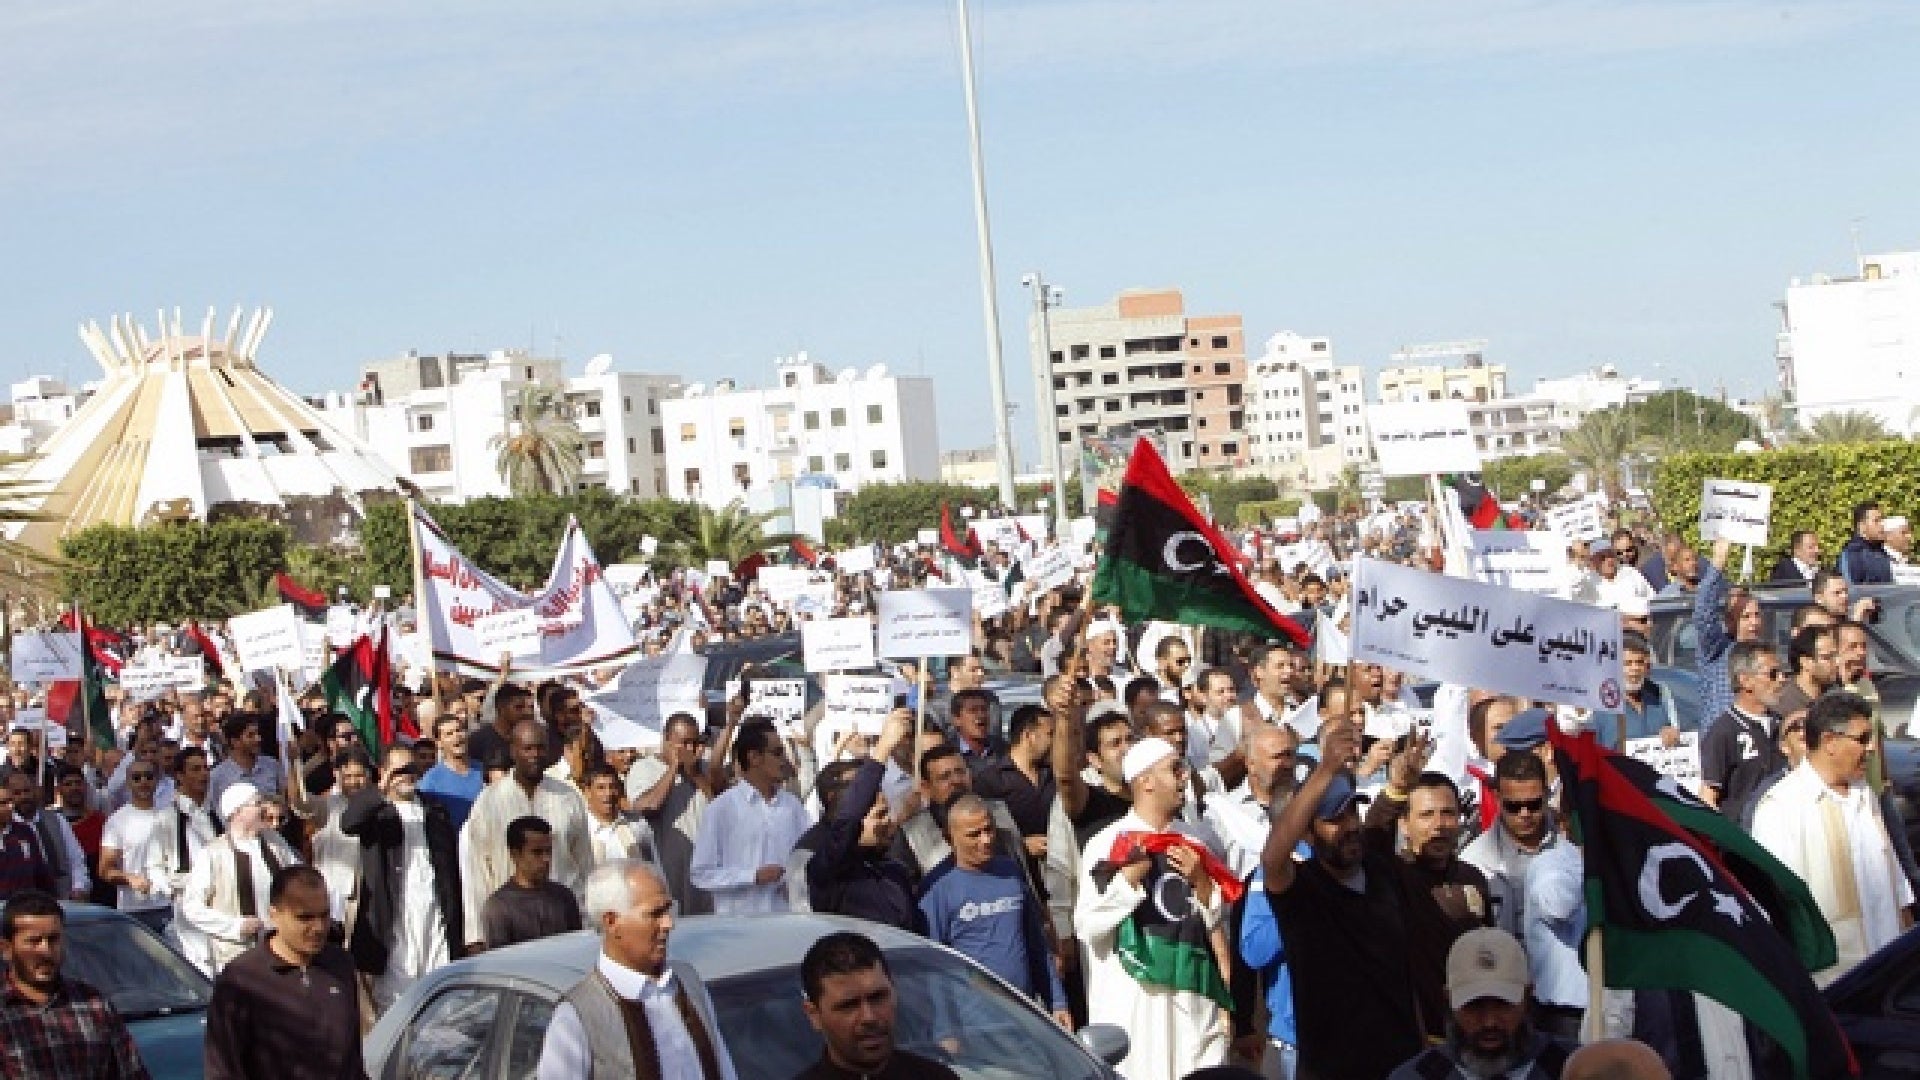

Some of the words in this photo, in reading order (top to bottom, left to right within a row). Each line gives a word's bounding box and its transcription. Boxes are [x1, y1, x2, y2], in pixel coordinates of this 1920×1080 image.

[1356, 584, 1408, 622] حرام
[1412, 604, 1489, 640] الليبي
[1490, 614, 1535, 647] على
[1538, 626, 1595, 663] الليبي
[1736, 732, 1760, 761] 2
